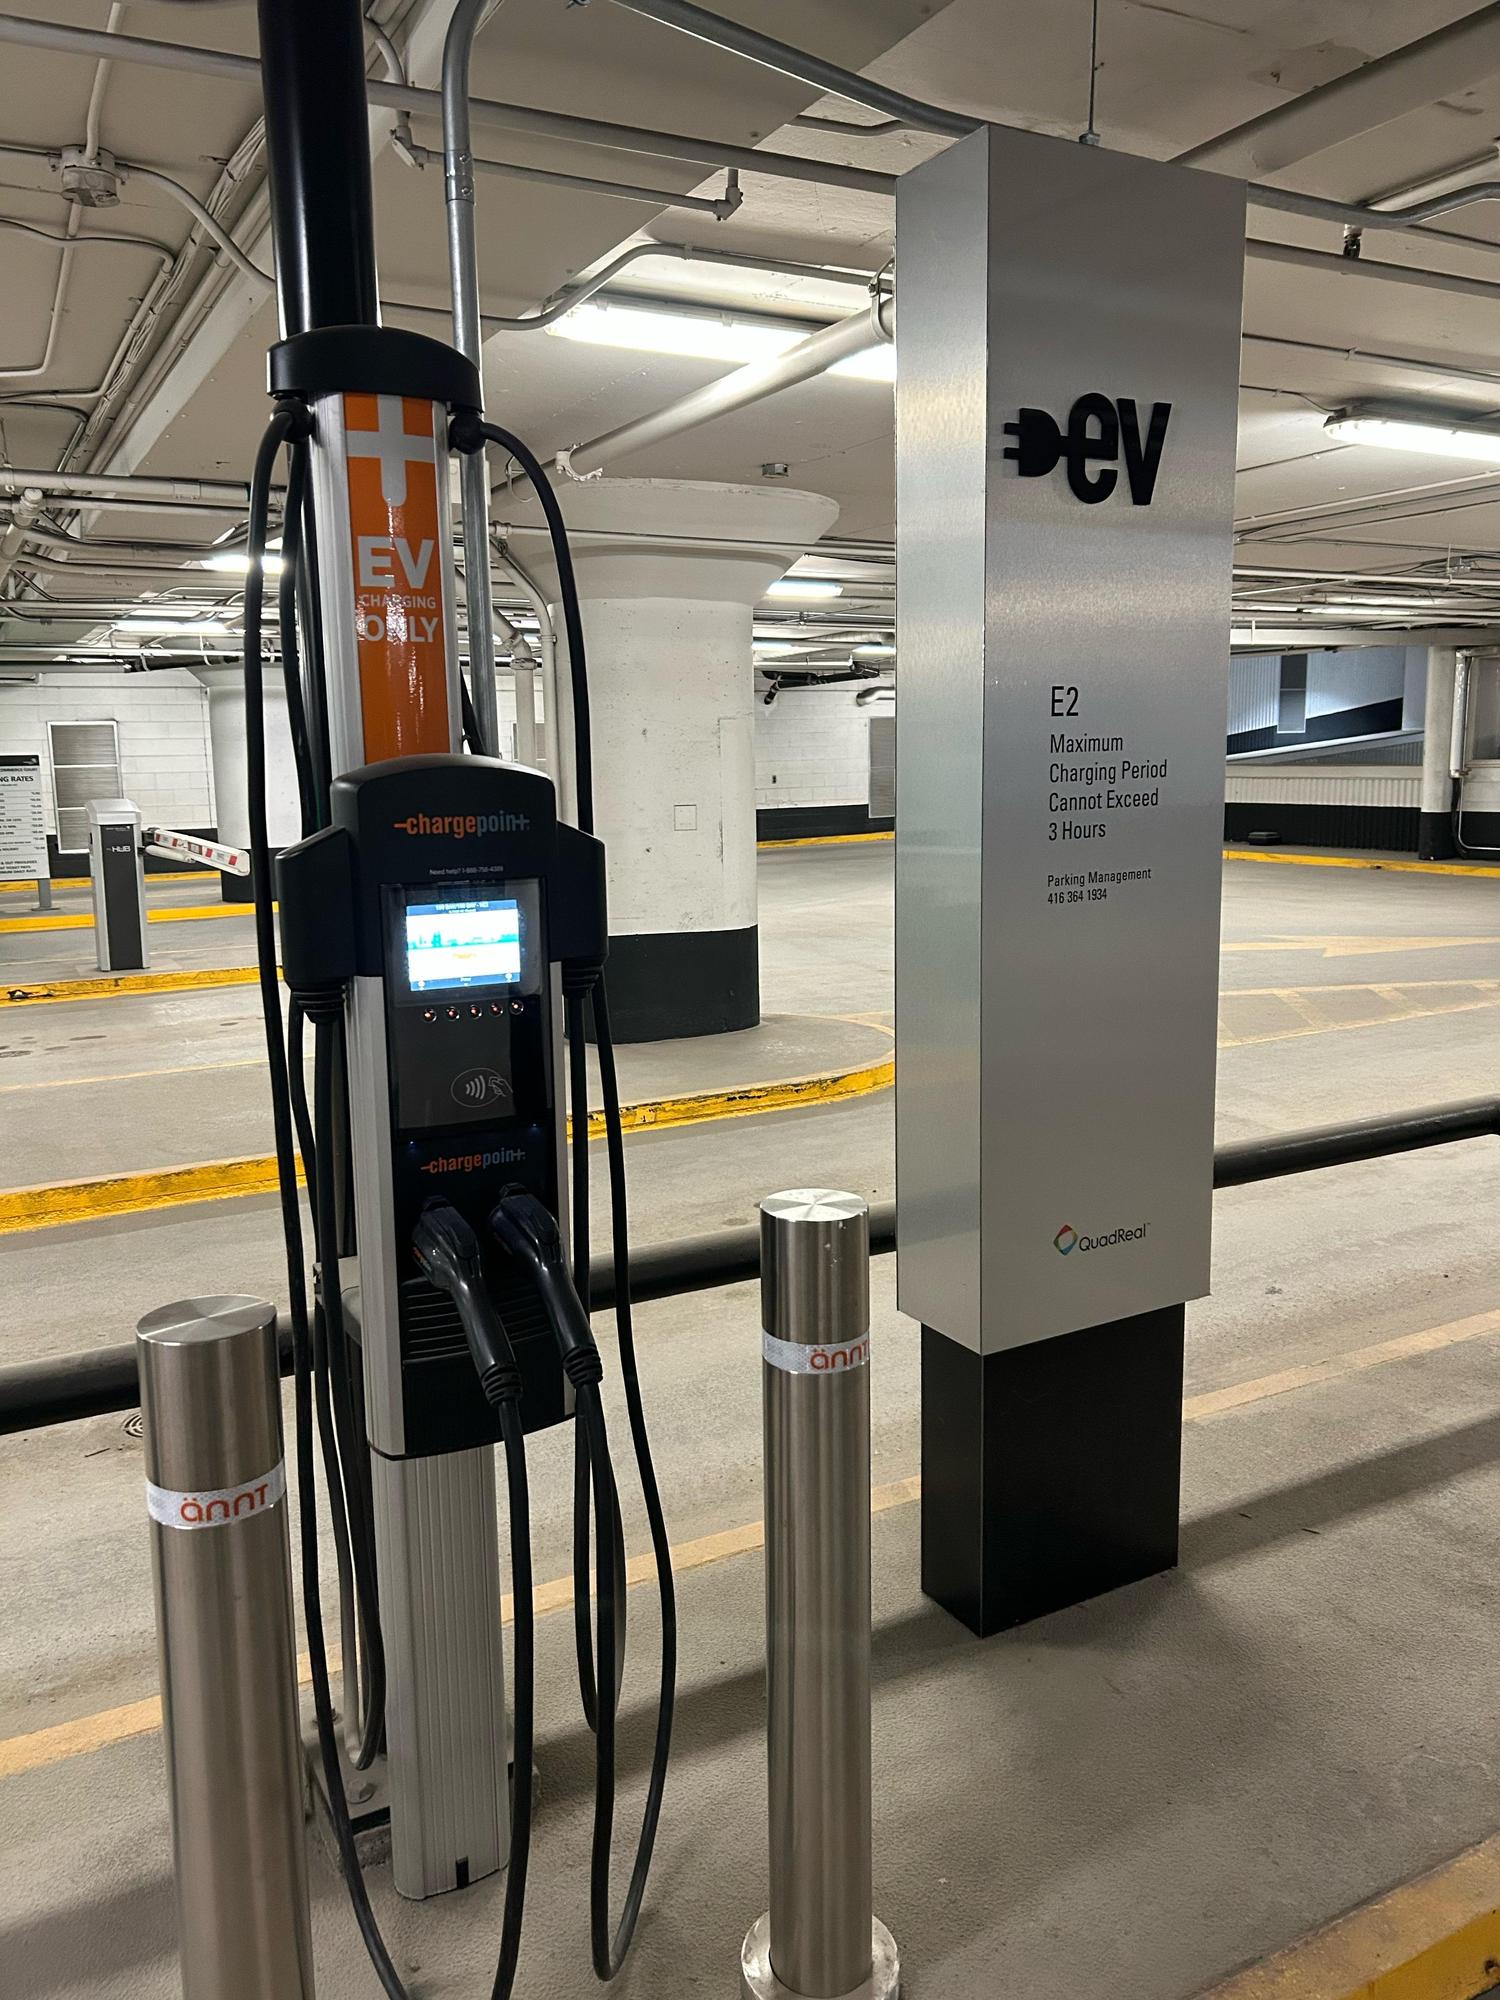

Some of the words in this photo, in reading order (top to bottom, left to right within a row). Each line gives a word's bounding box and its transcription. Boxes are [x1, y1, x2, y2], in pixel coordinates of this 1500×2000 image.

[357, 535, 435, 589] EV
[1051, 686, 1079, 717] E2
[1050, 733, 1123, 754] Maximum
[1050, 763, 1116, 786] Charging
[1122, 759, 1168, 780] Period
[1049, 792, 1103, 812] Cannot
[1106, 788, 1159, 809] Exceed
[1048, 822, 1057, 841] 3
[1062, 821, 1106, 840] Hours
[111, 845, 131, 853] HUB
[1048, 871, 1085, 887] Parking
[1088, 868, 1152, 884] Management
[1048, 891, 1064, 904] 416
[1067, 890, 1084, 903] 364
[1087, 888, 1107, 901] 1934
[1079, 1223, 1146, 1252] QuadReal
